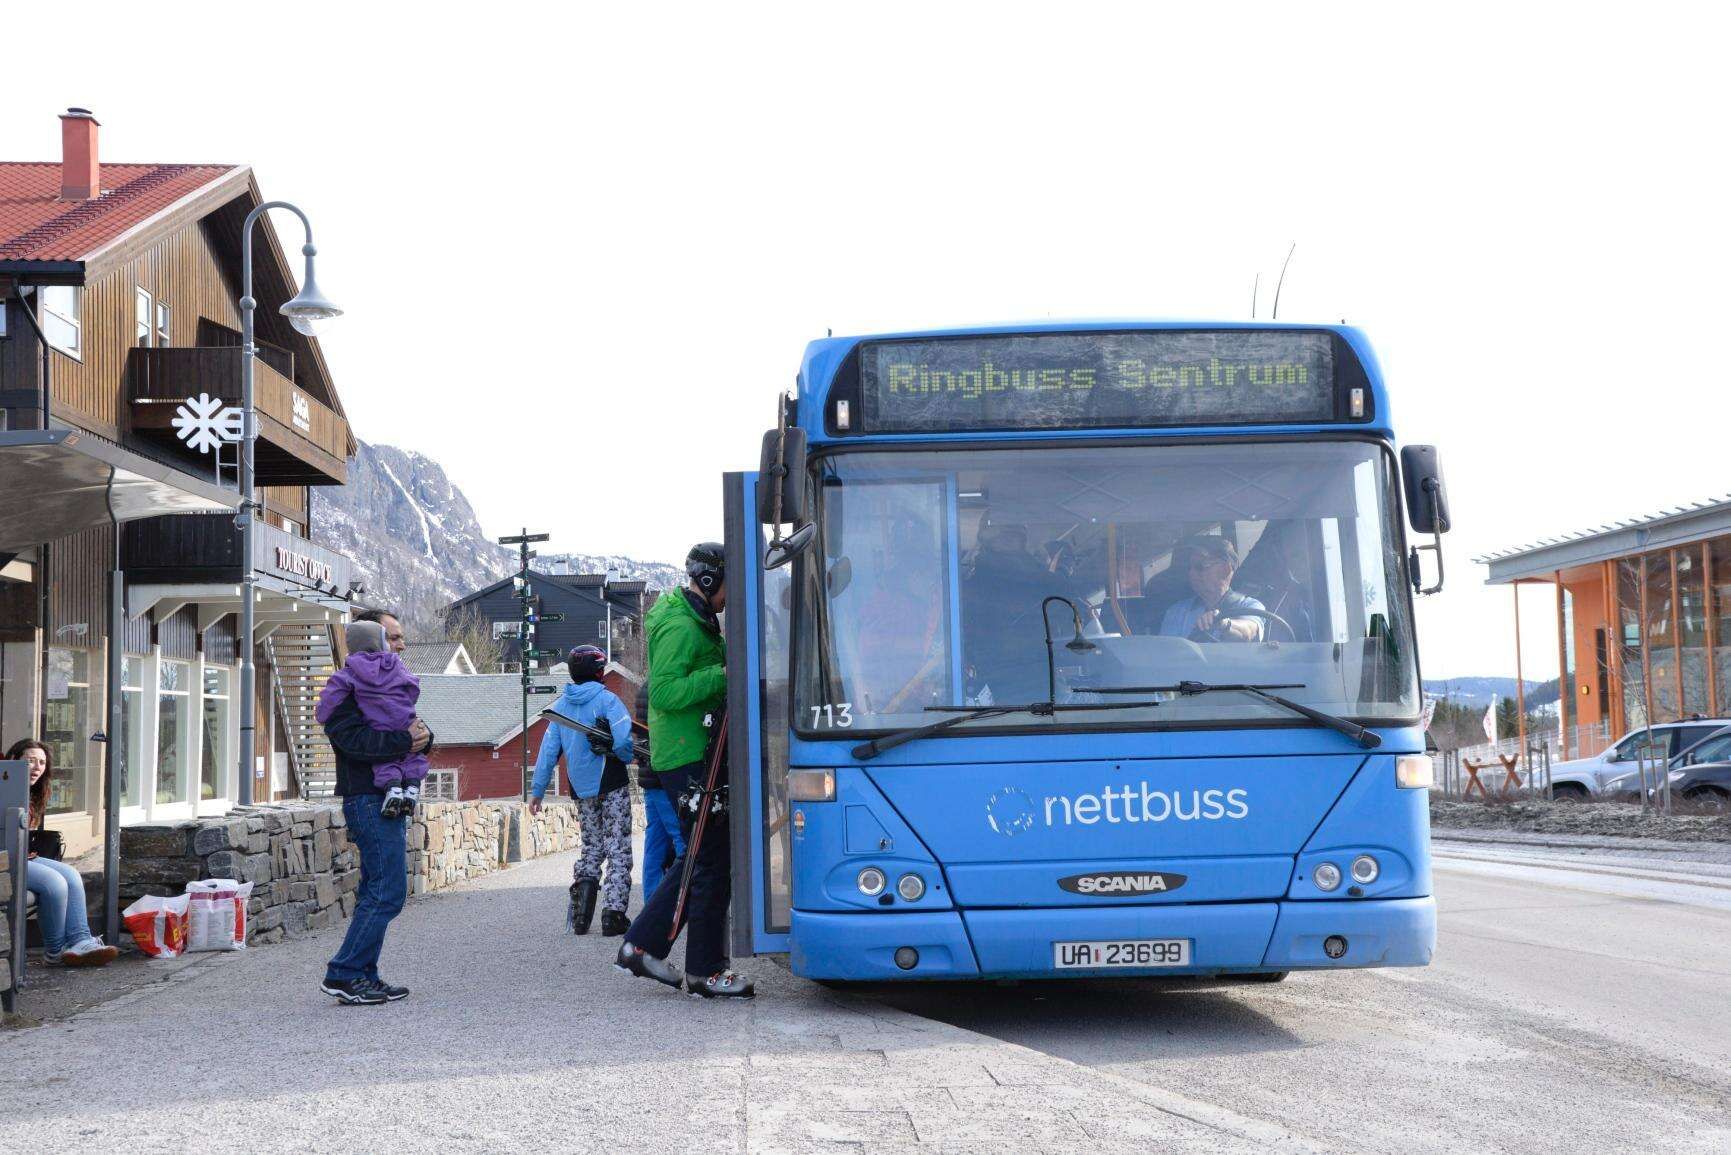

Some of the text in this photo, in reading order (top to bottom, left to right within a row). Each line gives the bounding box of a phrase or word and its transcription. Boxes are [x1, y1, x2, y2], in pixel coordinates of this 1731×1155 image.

[888, 358, 1308, 398] Ringbuss Sentrum
[277, 546, 310, 577] TOURIST
[810, 702, 853, 730] 713
[1044, 781, 1249, 826] nettbuss
[1077, 875, 1167, 893] SCANIA
[1061, 942, 1182, 965] UA 23699
